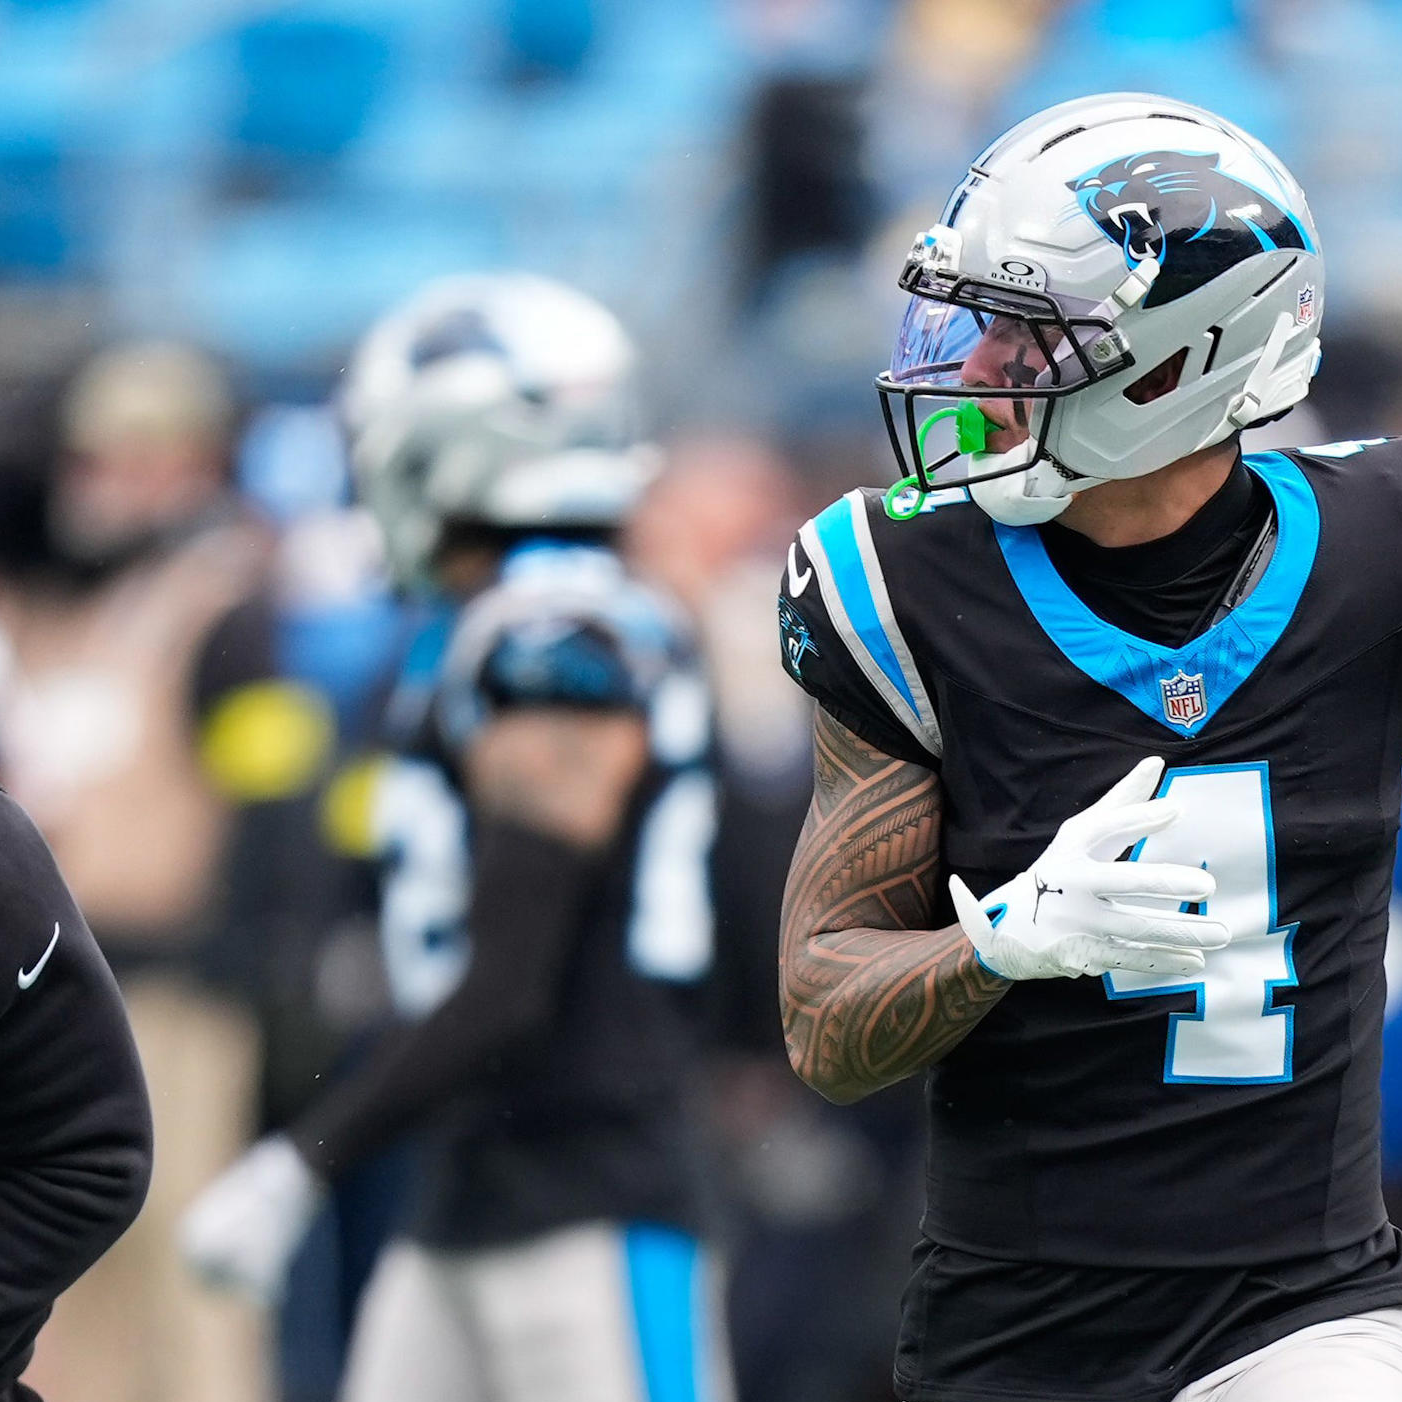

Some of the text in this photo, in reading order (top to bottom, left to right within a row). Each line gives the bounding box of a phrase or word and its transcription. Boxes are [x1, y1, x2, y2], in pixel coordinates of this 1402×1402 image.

[991, 272, 1042, 288] OAKLEY
[1169, 696, 1201, 717] NFL
[1102, 760, 1300, 1085] 4
